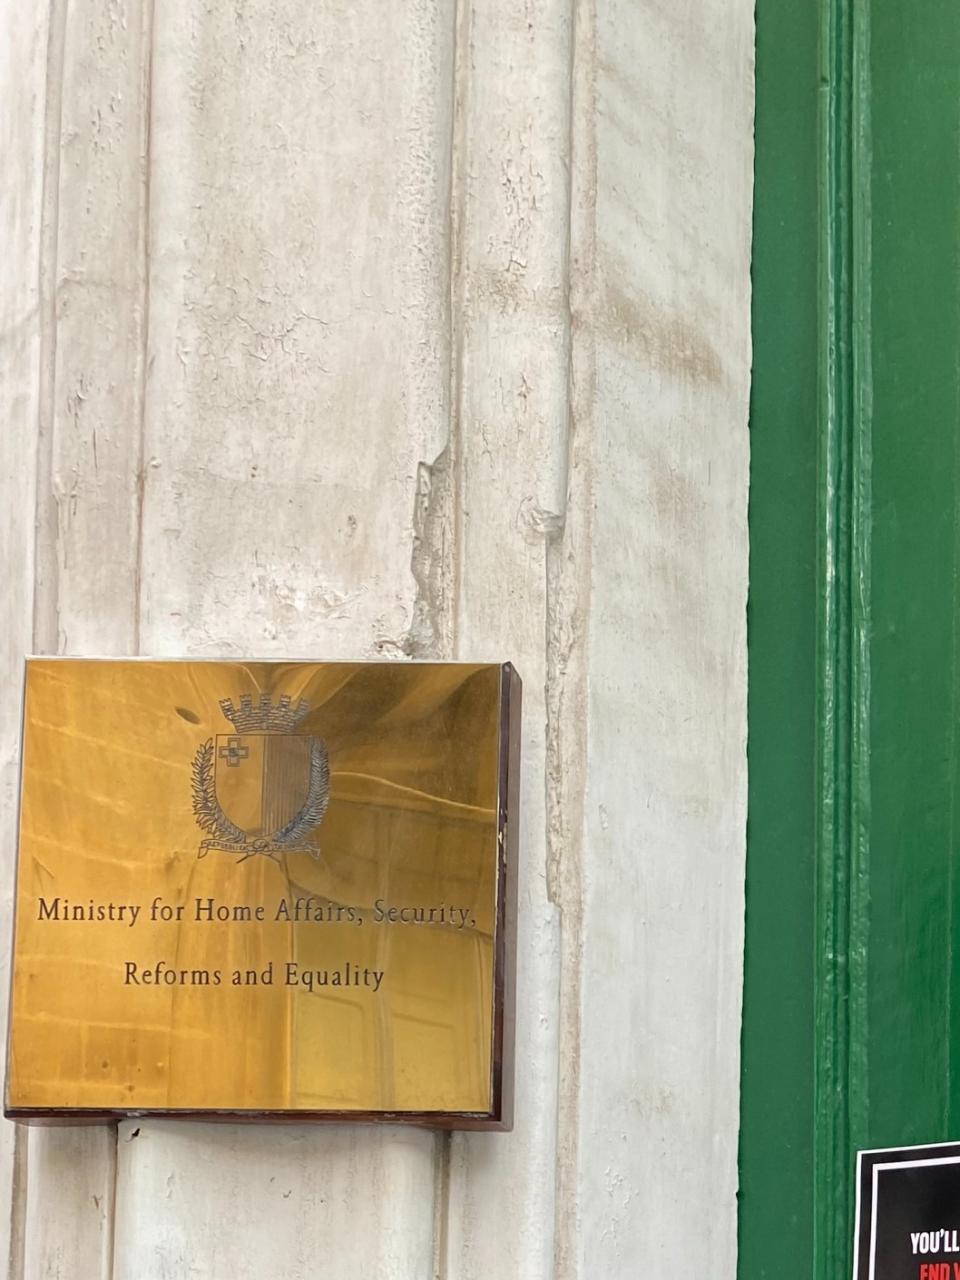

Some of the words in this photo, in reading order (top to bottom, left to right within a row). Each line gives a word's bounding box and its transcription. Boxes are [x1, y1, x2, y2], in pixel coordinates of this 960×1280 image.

[38, 898, 141, 927] Ministry
[150, 897, 184, 921] for
[195, 898, 265, 921] Home
[275, 898, 363, 926] Affairs,
[374, 899, 477, 929] Security,
[124, 961, 222, 985] Reforms
[232, 962, 273, 986] and
[285, 962, 385, 993] Equality
[910, 1228, 960, 1254] YOU’LL
